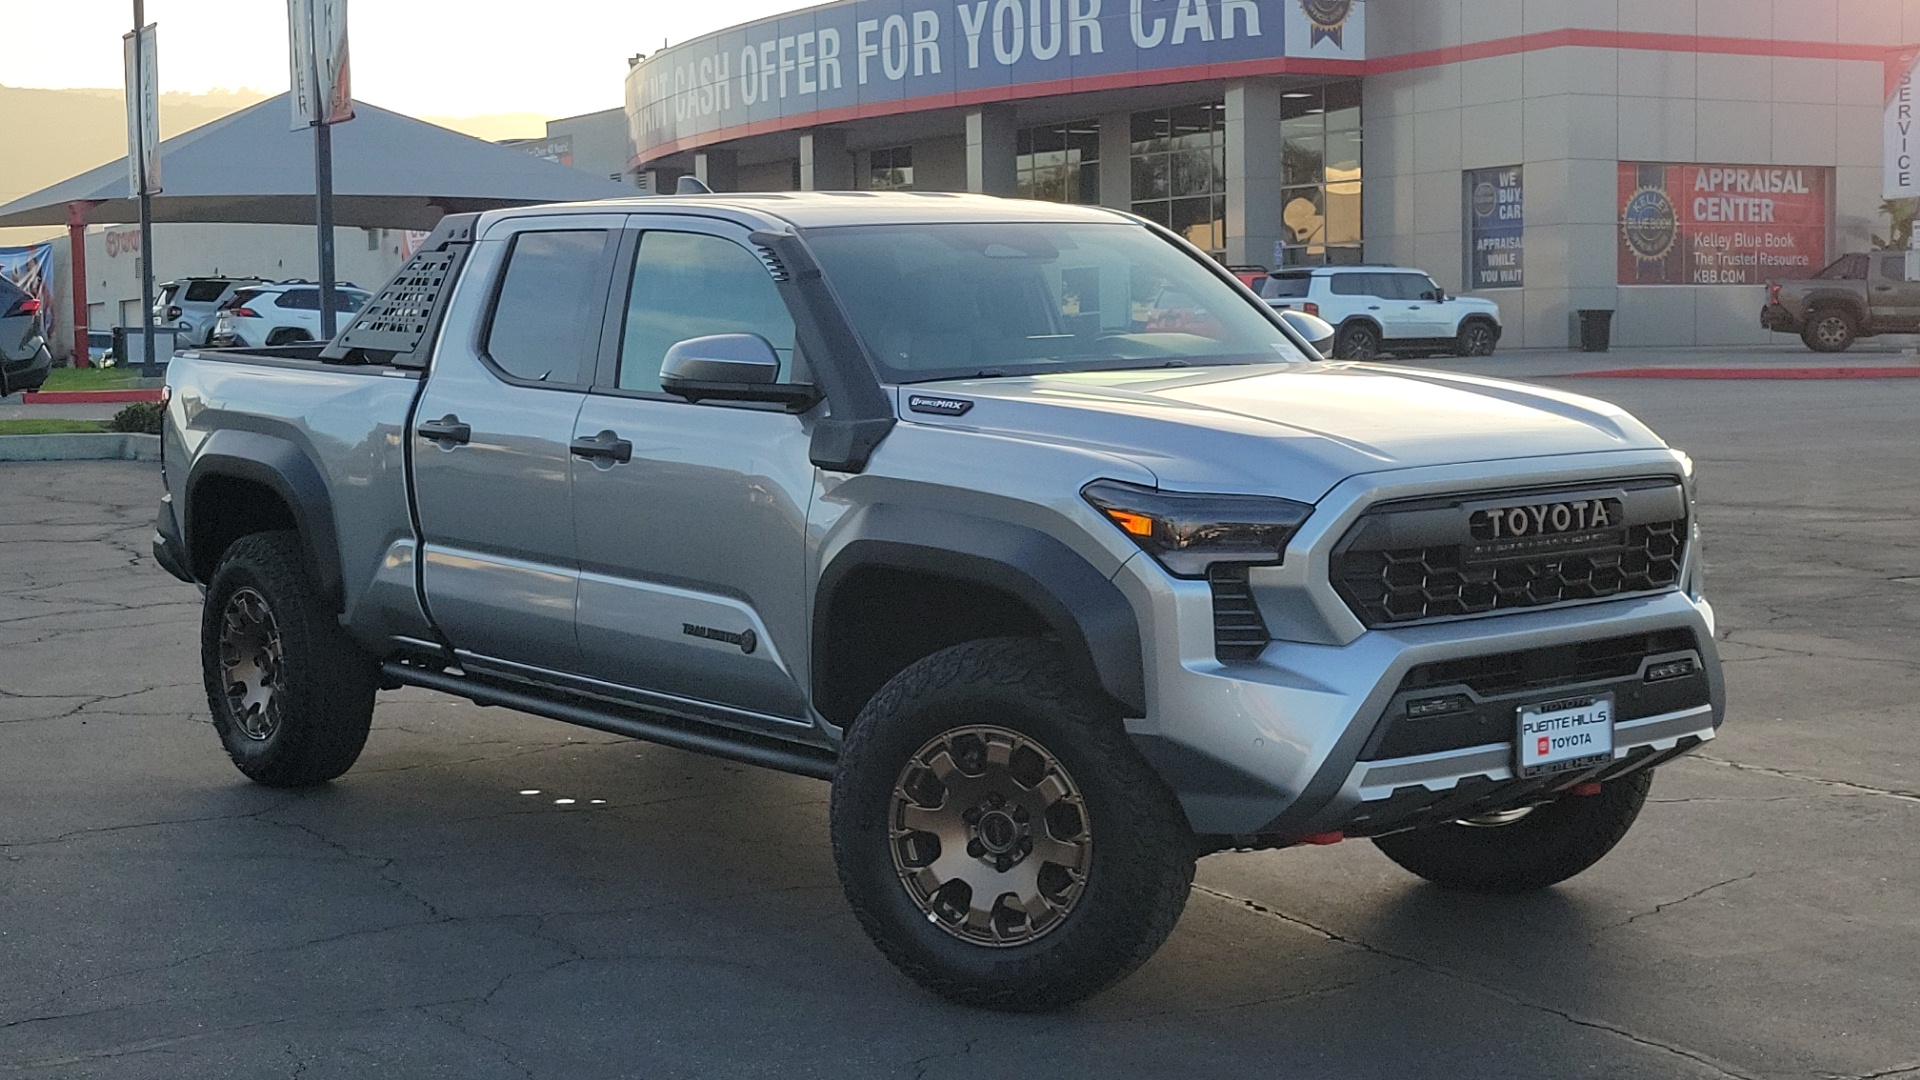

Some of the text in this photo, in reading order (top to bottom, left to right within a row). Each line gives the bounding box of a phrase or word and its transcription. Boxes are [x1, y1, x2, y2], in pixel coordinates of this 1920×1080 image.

[674, 51, 730, 122] CASH
[740, 27, 842, 106] OFFER
[857, 10, 941, 84] FOR
[957, 0, 1104, 69] YOUR
[1129, 0, 1262, 49] CAR
[1898, 71, 1912, 187] SERVICE
[1499, 172, 1517, 188] WE
[1694, 168, 1809, 193] APPRAISAL
[1499, 188, 1521, 204] BUY
[1693, 197, 1775, 222] CENTER
[1694, 232, 1795, 251] Kelley Blue Book
[1487, 253, 1516, 267] WHILE
[1694, 252, 1809, 266] The Trusted Resource
[1480, 269, 1522, 283] YOU WAIT
[1694, 269, 1746, 283] KBB.COM
[1487, 500, 1609, 537] TOYOTA
[1542, 700, 1590, 711] TOYOTA
[1523, 711, 1607, 735] PUENTE HILLS
[1551, 733, 1592, 749] TOYOTA
